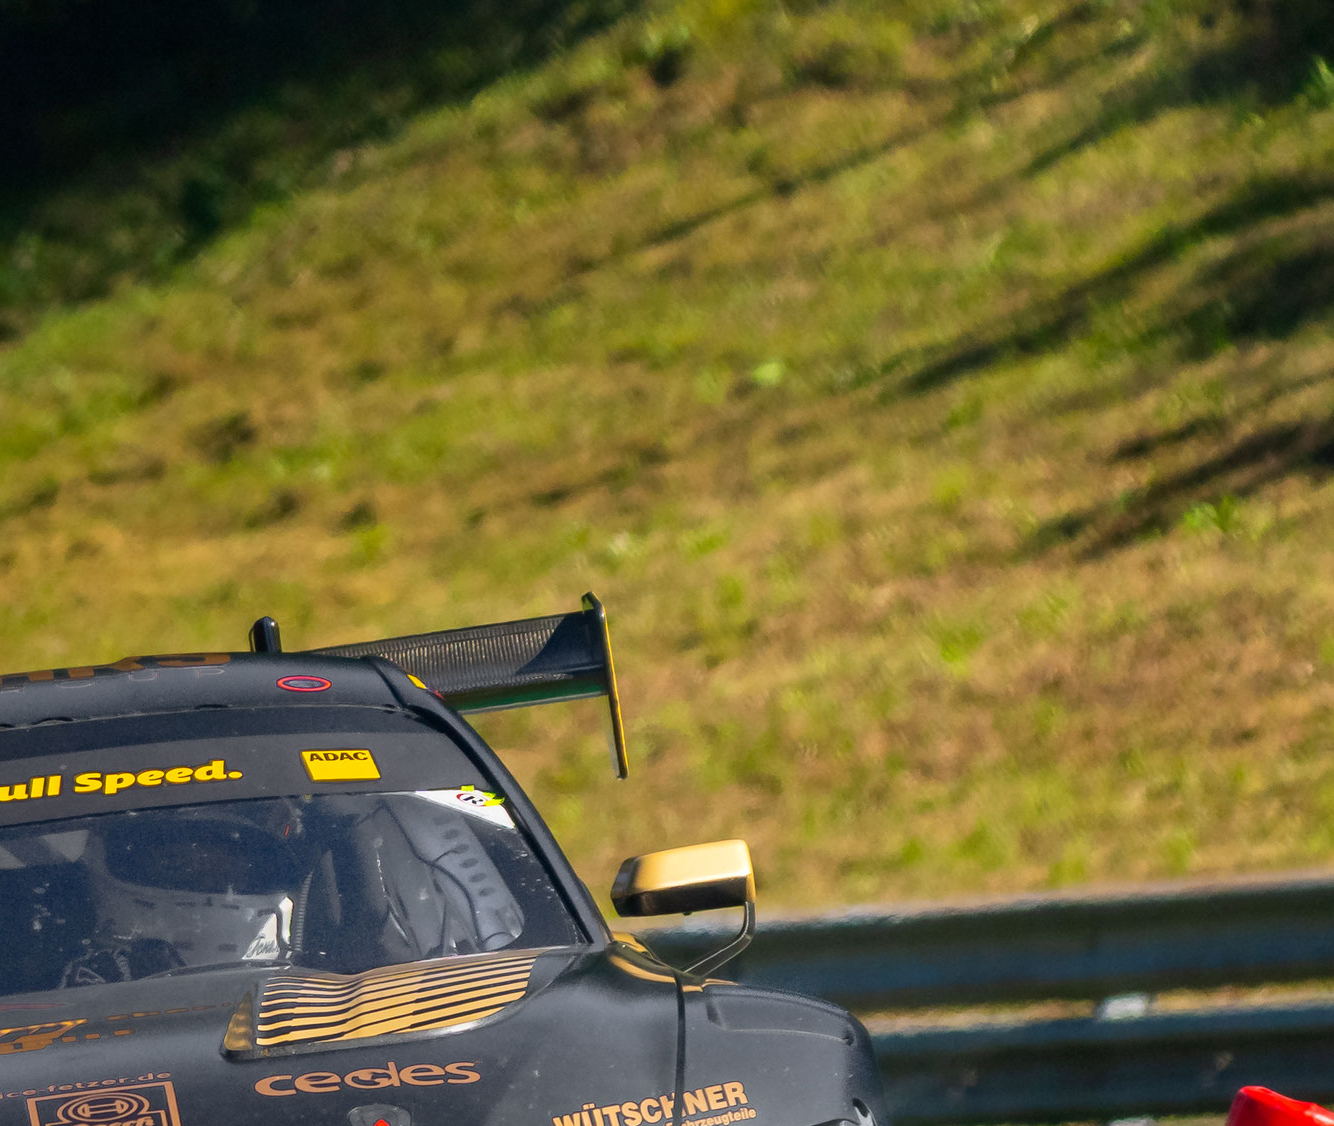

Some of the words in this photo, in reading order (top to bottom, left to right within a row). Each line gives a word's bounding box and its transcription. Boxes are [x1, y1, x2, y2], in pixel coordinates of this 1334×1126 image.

[309, 750, 369, 762] ADAC
[74, 760, 244, 795] Speed.
[254, 1061, 482, 1097] cedes
